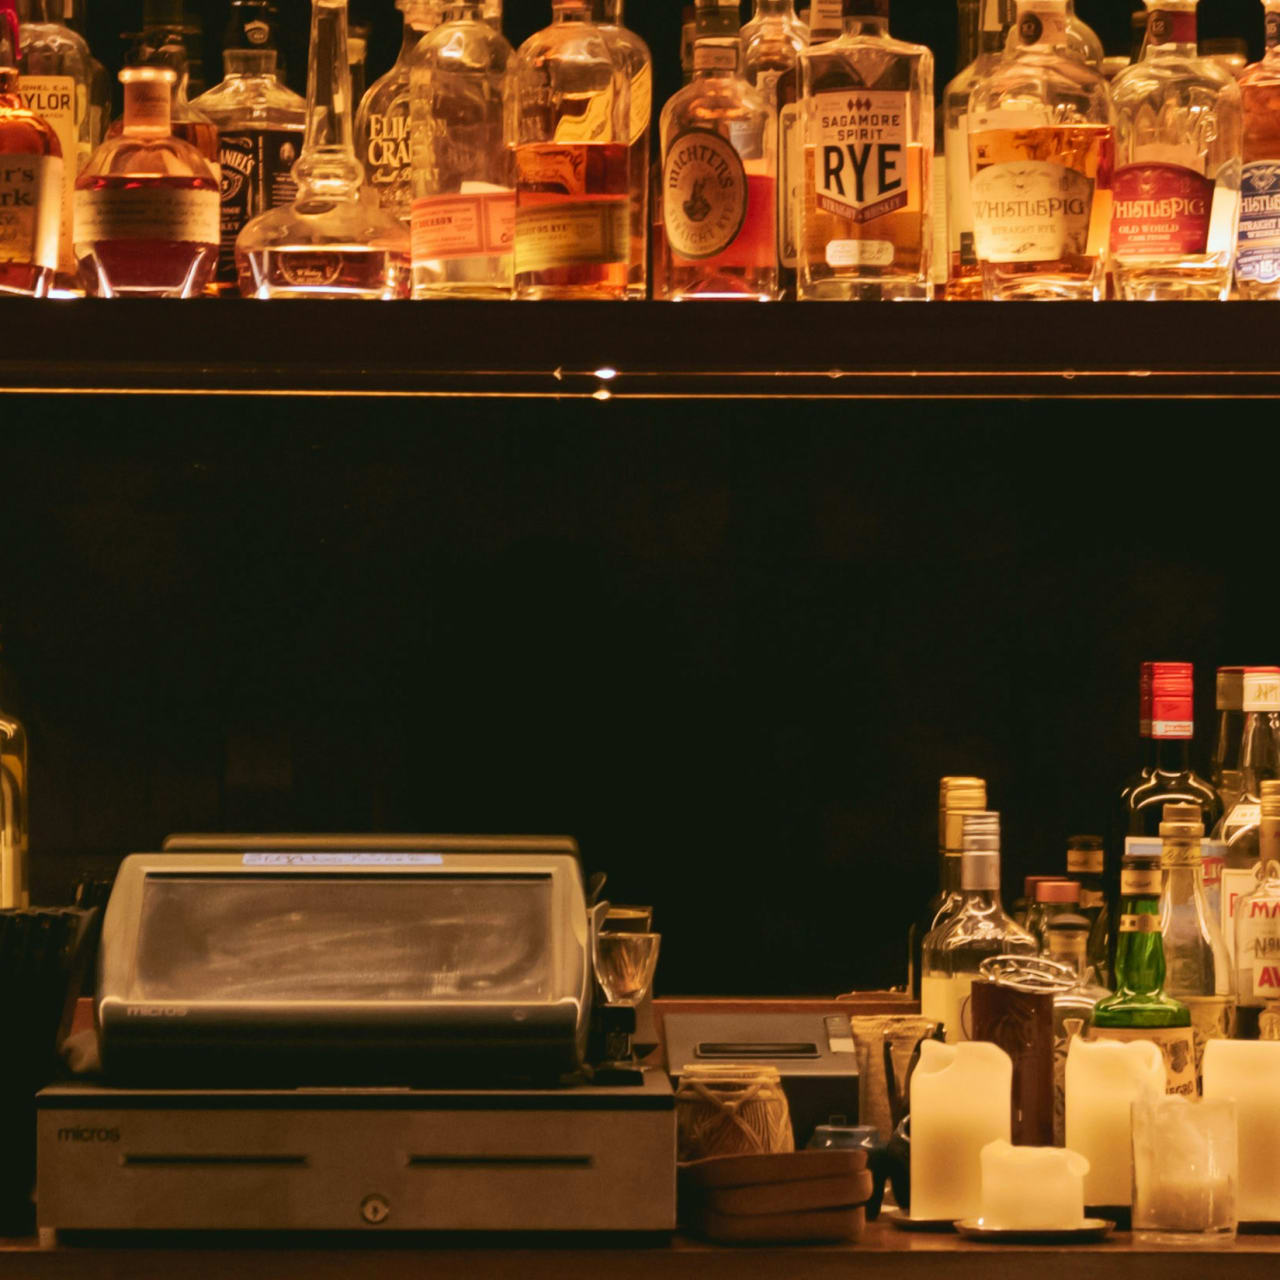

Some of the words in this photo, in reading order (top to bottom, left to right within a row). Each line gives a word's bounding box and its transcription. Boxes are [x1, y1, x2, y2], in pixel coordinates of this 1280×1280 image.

[821, 114, 901, 130] SAGAMORE
[842, 128, 884, 142] SPIRIT
[823, 143, 903, 203] RYE
[56, 1126, 121, 1143] micros
